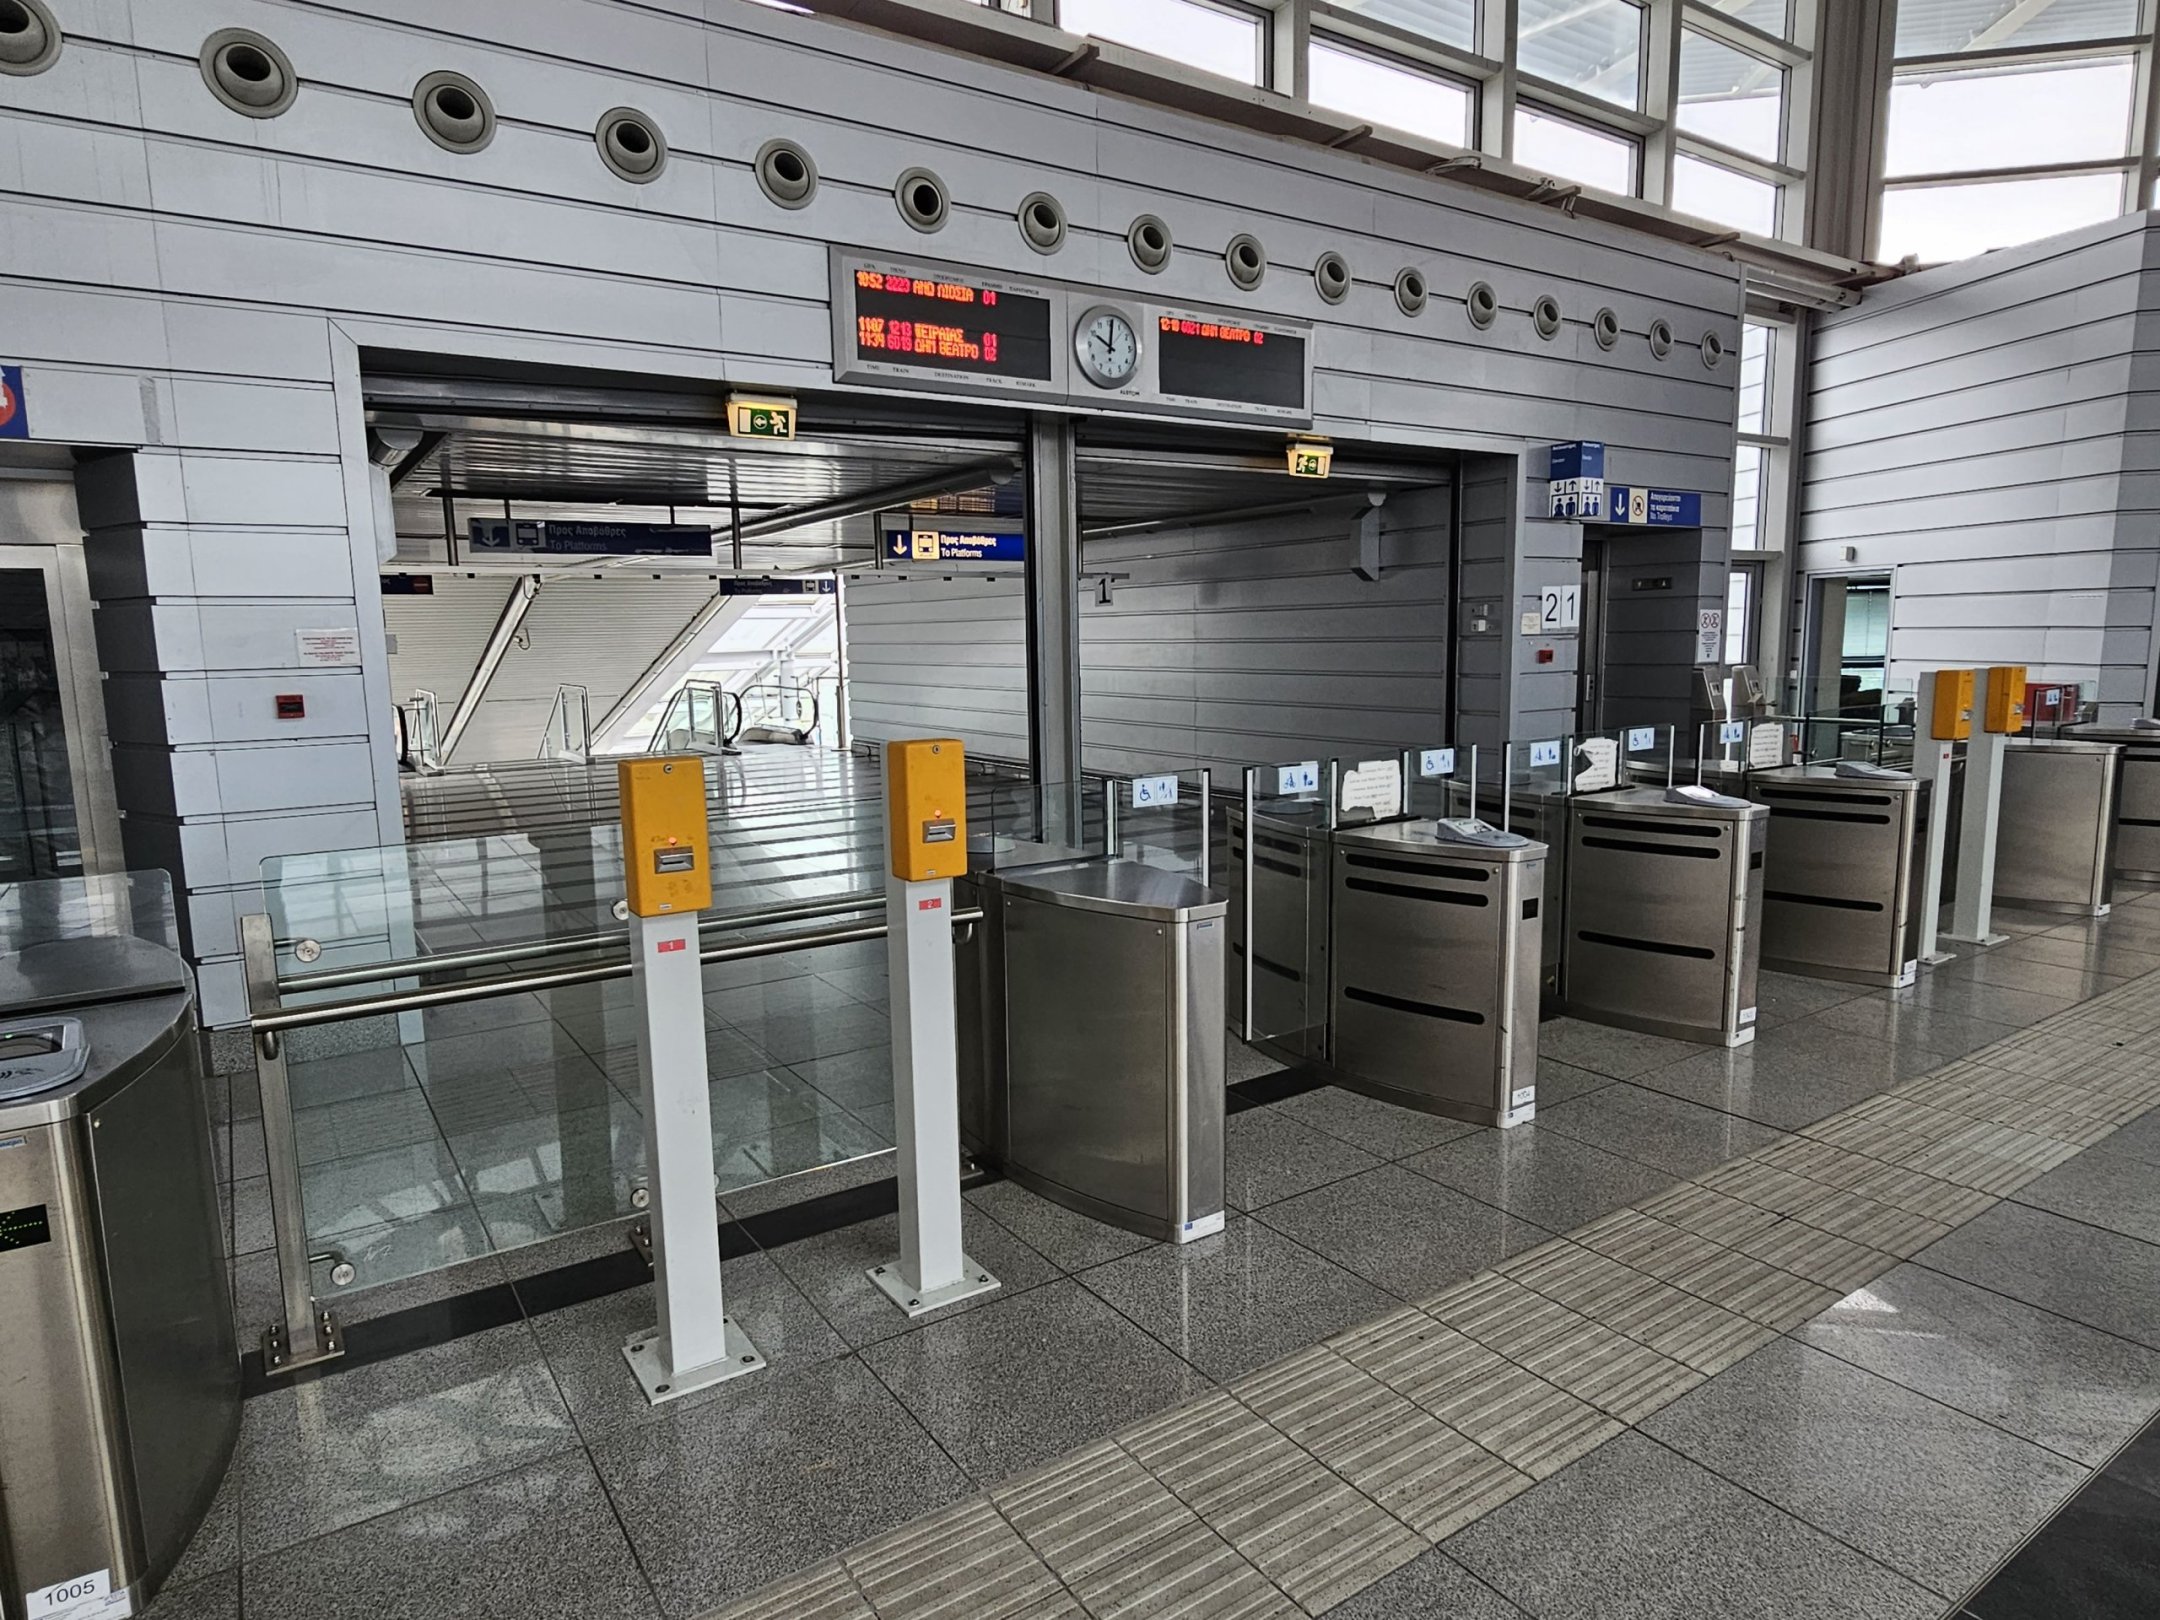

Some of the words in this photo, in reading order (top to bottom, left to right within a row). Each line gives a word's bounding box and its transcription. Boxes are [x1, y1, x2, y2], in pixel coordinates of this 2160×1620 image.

[982, 289, 997, 306] 01
[983, 332, 997, 348] 01
[984, 347, 997, 362] 02
[548, 524, 574, 537] Προς
[549, 540, 562, 551] To
[940, 547, 951, 557] To
[950, 547, 983, 558] Platforms
[45, 1579, 96, 1606] 1005
